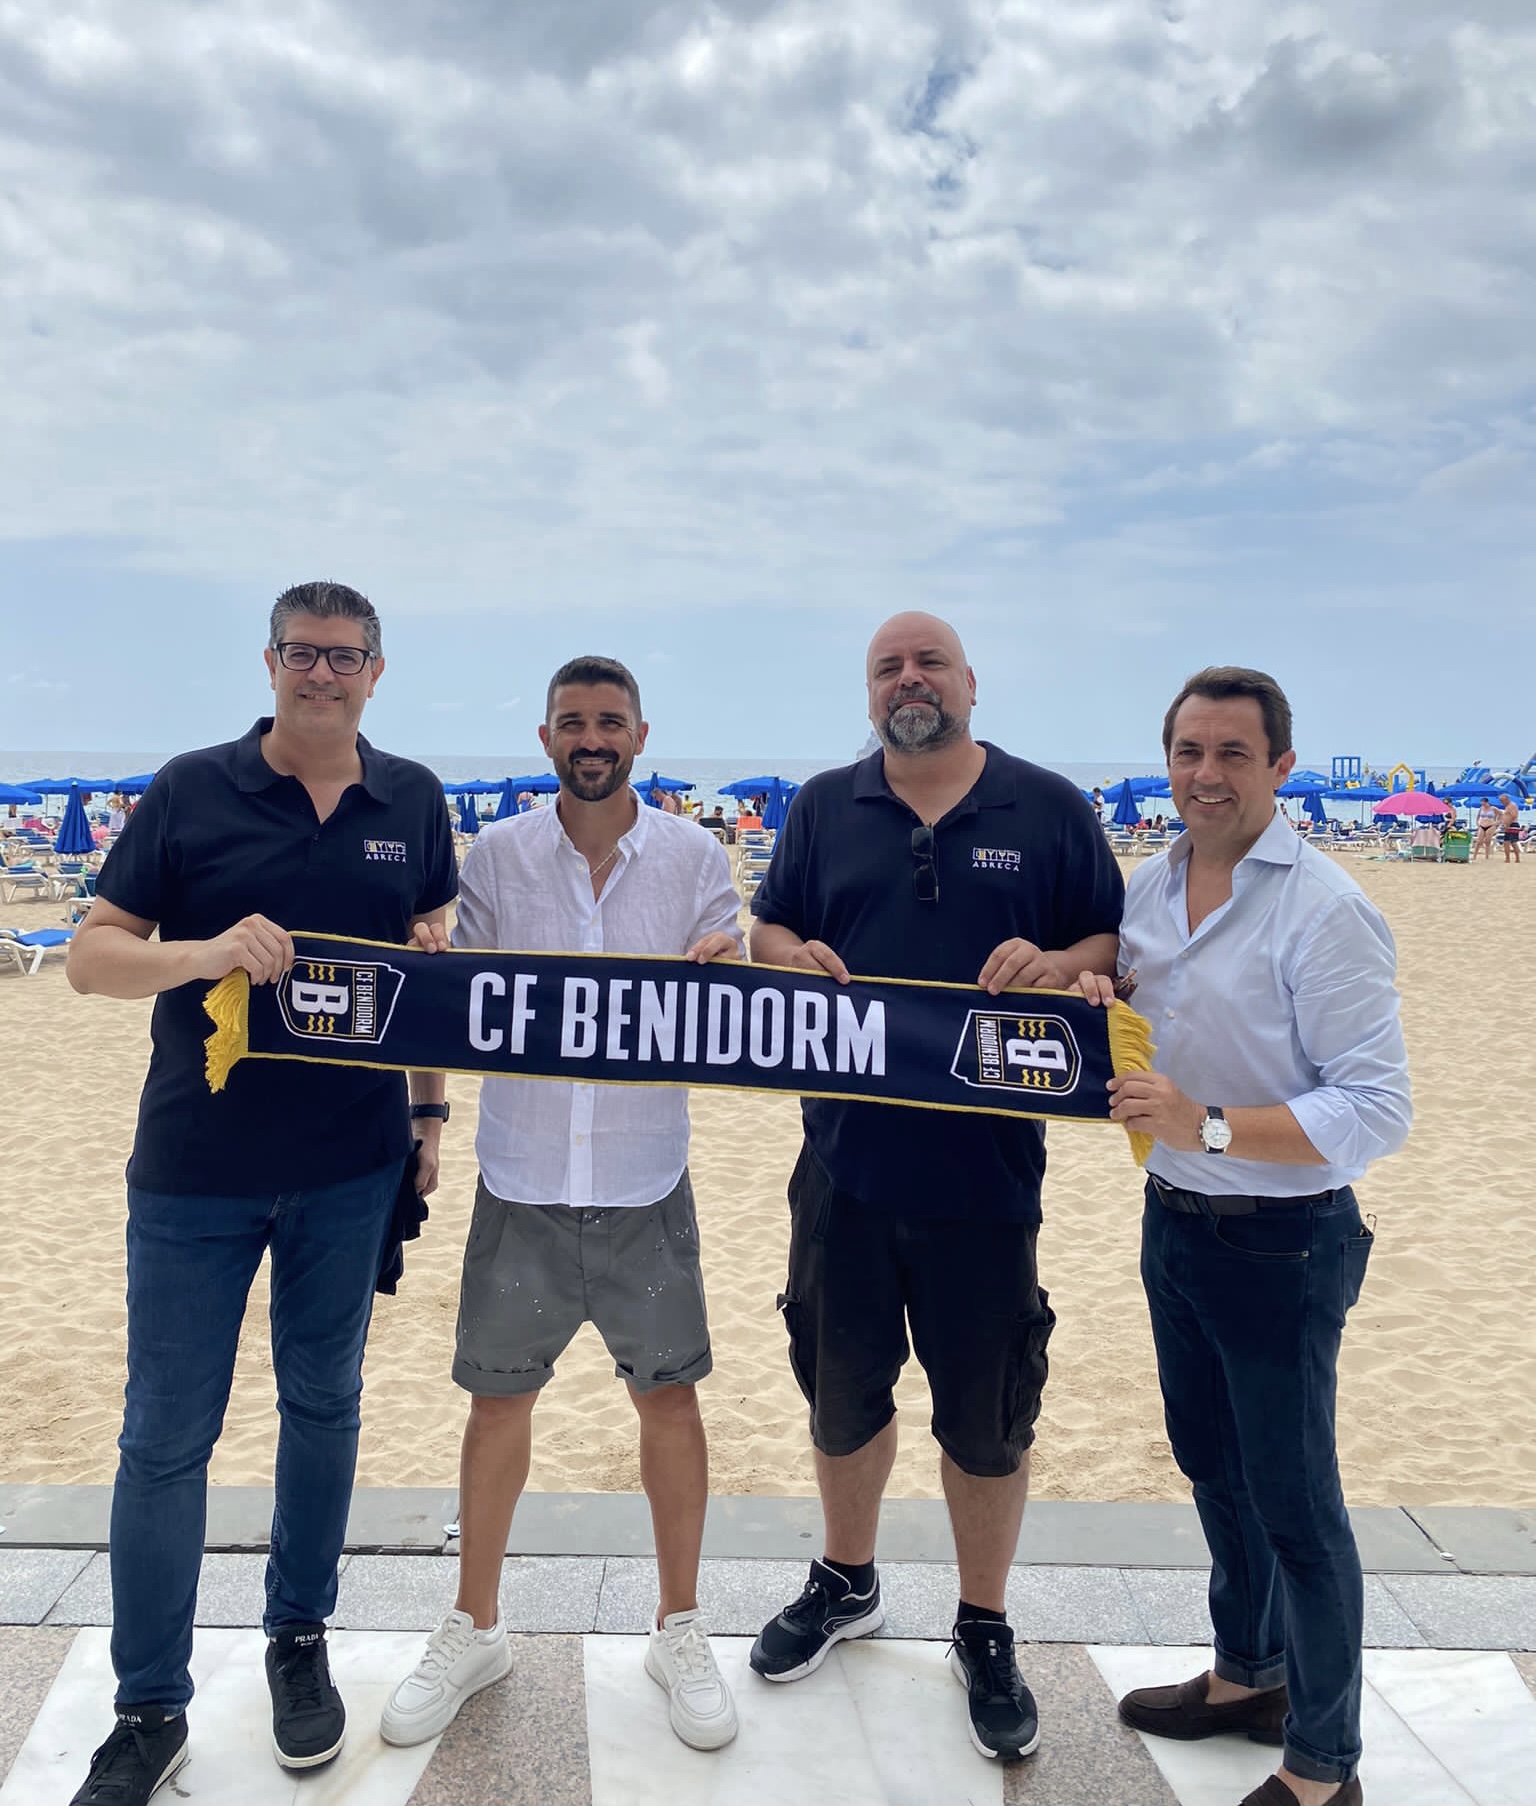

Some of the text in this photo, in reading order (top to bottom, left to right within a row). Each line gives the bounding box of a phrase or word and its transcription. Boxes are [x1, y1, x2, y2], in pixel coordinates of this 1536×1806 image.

[365, 853, 407, 864] ABRECA
[972, 861, 1020, 872] ABRECA
[291, 979, 350, 1015] B
[355, 970, 375, 1035] CF BENIDORM
[468, 971, 886, 1076] CF BENIDORM
[979, 1019, 1001, 1079] CF BENIDORM
[1005, 1038, 1068, 1072] B
